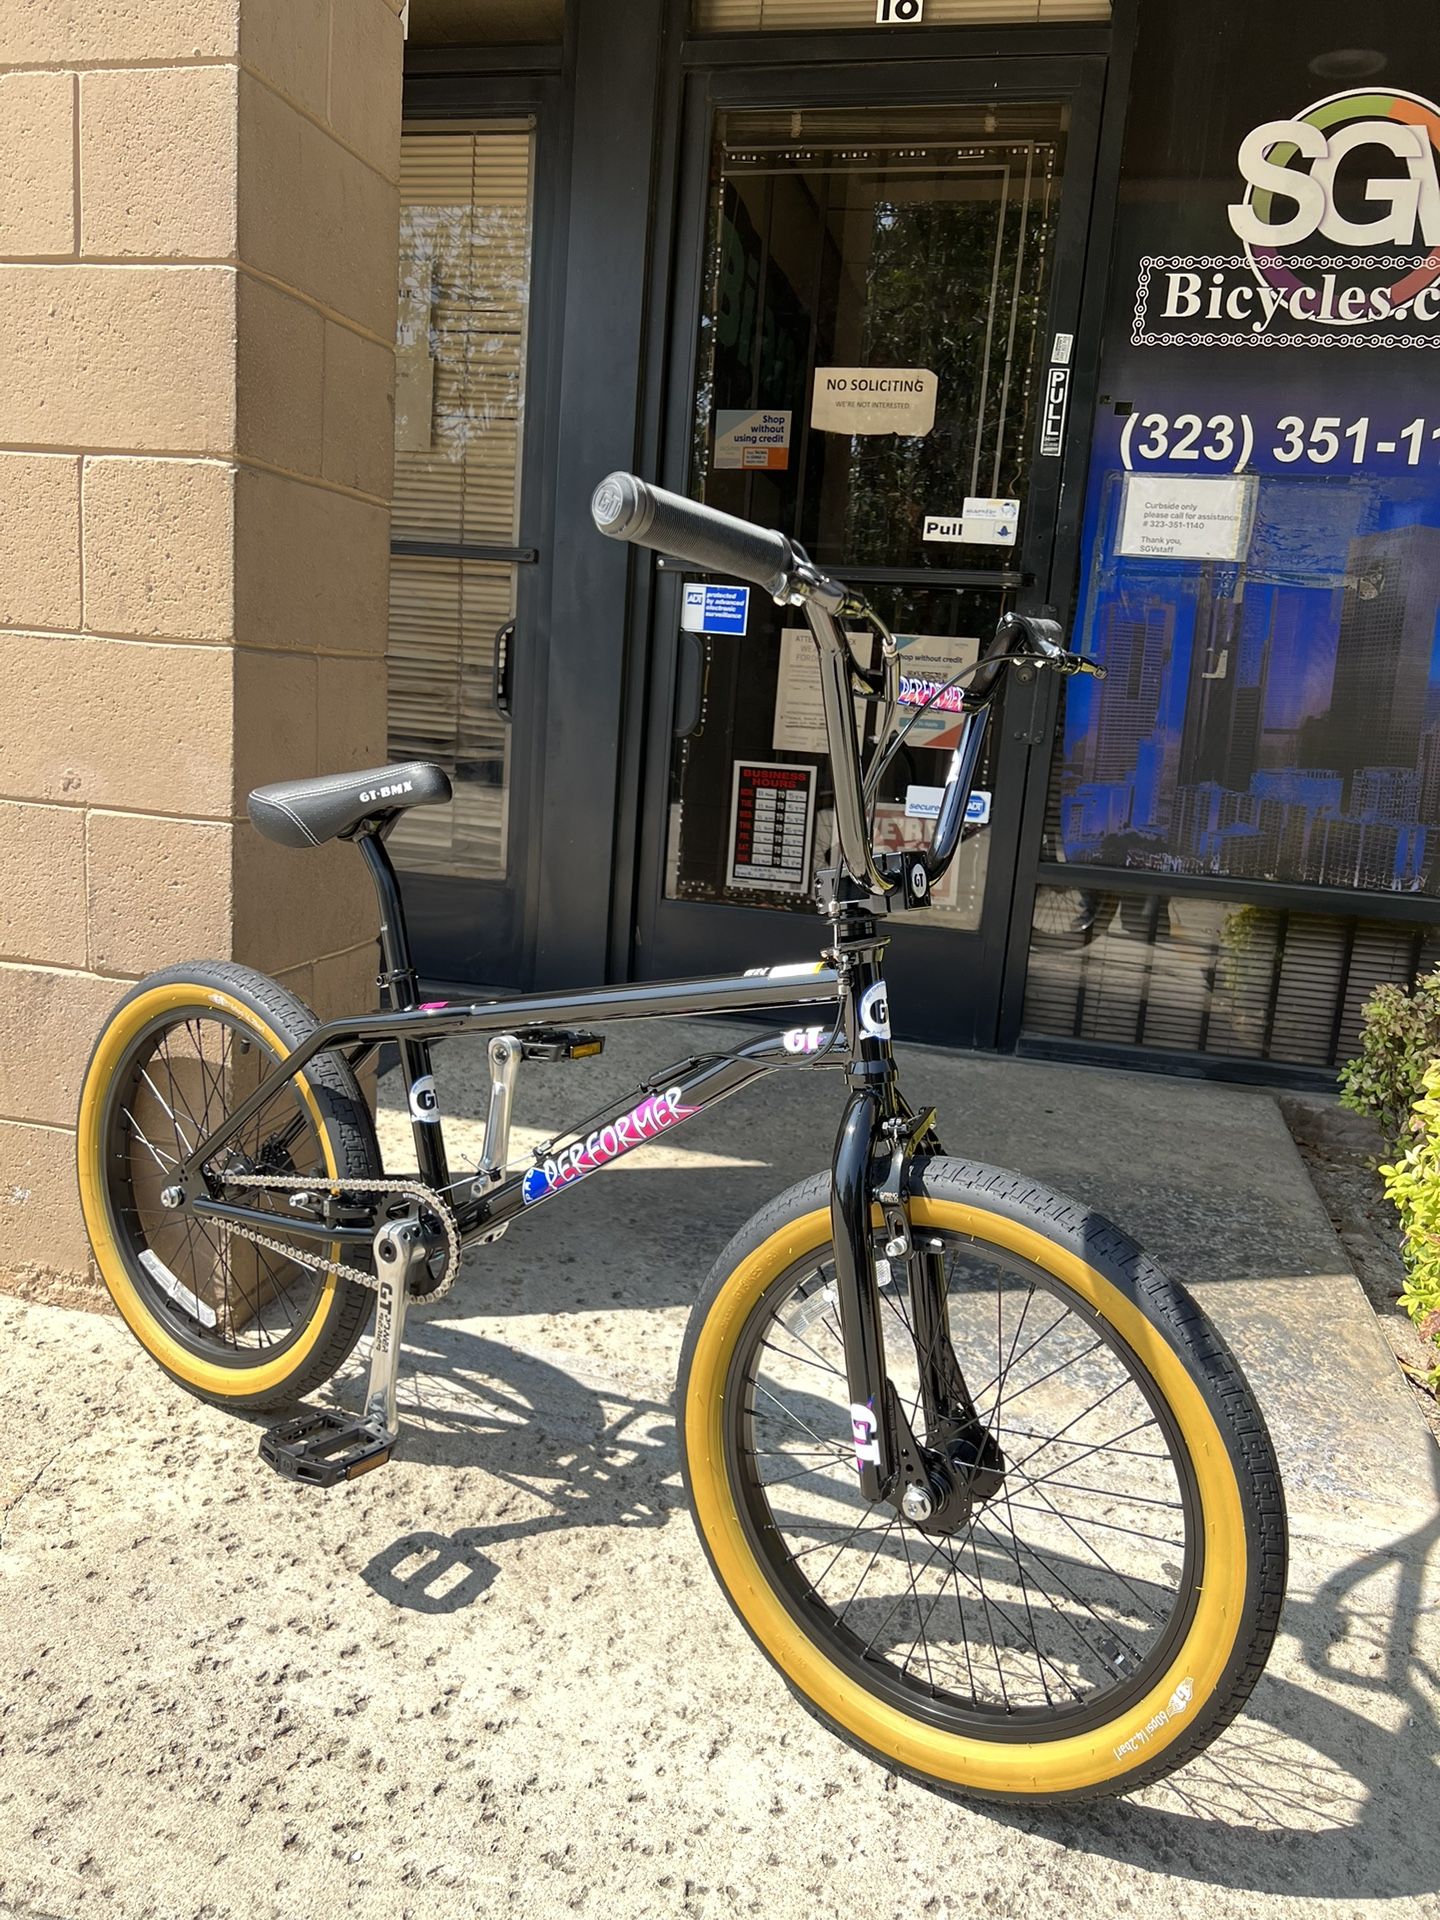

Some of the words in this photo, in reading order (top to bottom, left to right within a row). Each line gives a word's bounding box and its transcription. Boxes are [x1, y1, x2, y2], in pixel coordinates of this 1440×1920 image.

[827, 379, 847, 390] NO
[850, 379, 925, 392] SOLICITING
[1046, 371, 1065, 436] PULL
[762, 415, 785, 425] Shop
[751, 425, 784, 433] without
[734, 434, 757, 444] using
[758, 435, 784, 443] credit
[1120, 412, 1254, 473] (323)
[1145, 502, 1179, 510] Curbside
[1181, 503, 1198, 511] only
[1143, 512, 1169, 520] please
[1185, 512, 1196, 520] for
[926, 522, 963, 536] Pull
[1150, 521, 1205, 529] 323-351-1140
[1141, 536, 1165, 544] Thank
[688, 592, 703, 604] ADT
[706, 598, 715, 606] by
[914, 655, 941, 663] without
[942, 656, 963, 664] credit
[743, 769, 806, 781] BUSINESS
[752, 778, 797, 788] HOURS
[914, 873, 924, 887] GT
[783, 1025, 824, 1053] GT
[543, 1086, 696, 1191] PERFORMER
[380, 1282, 393, 1315] GT
[1145, 1711, 1169, 1738] 60psi
